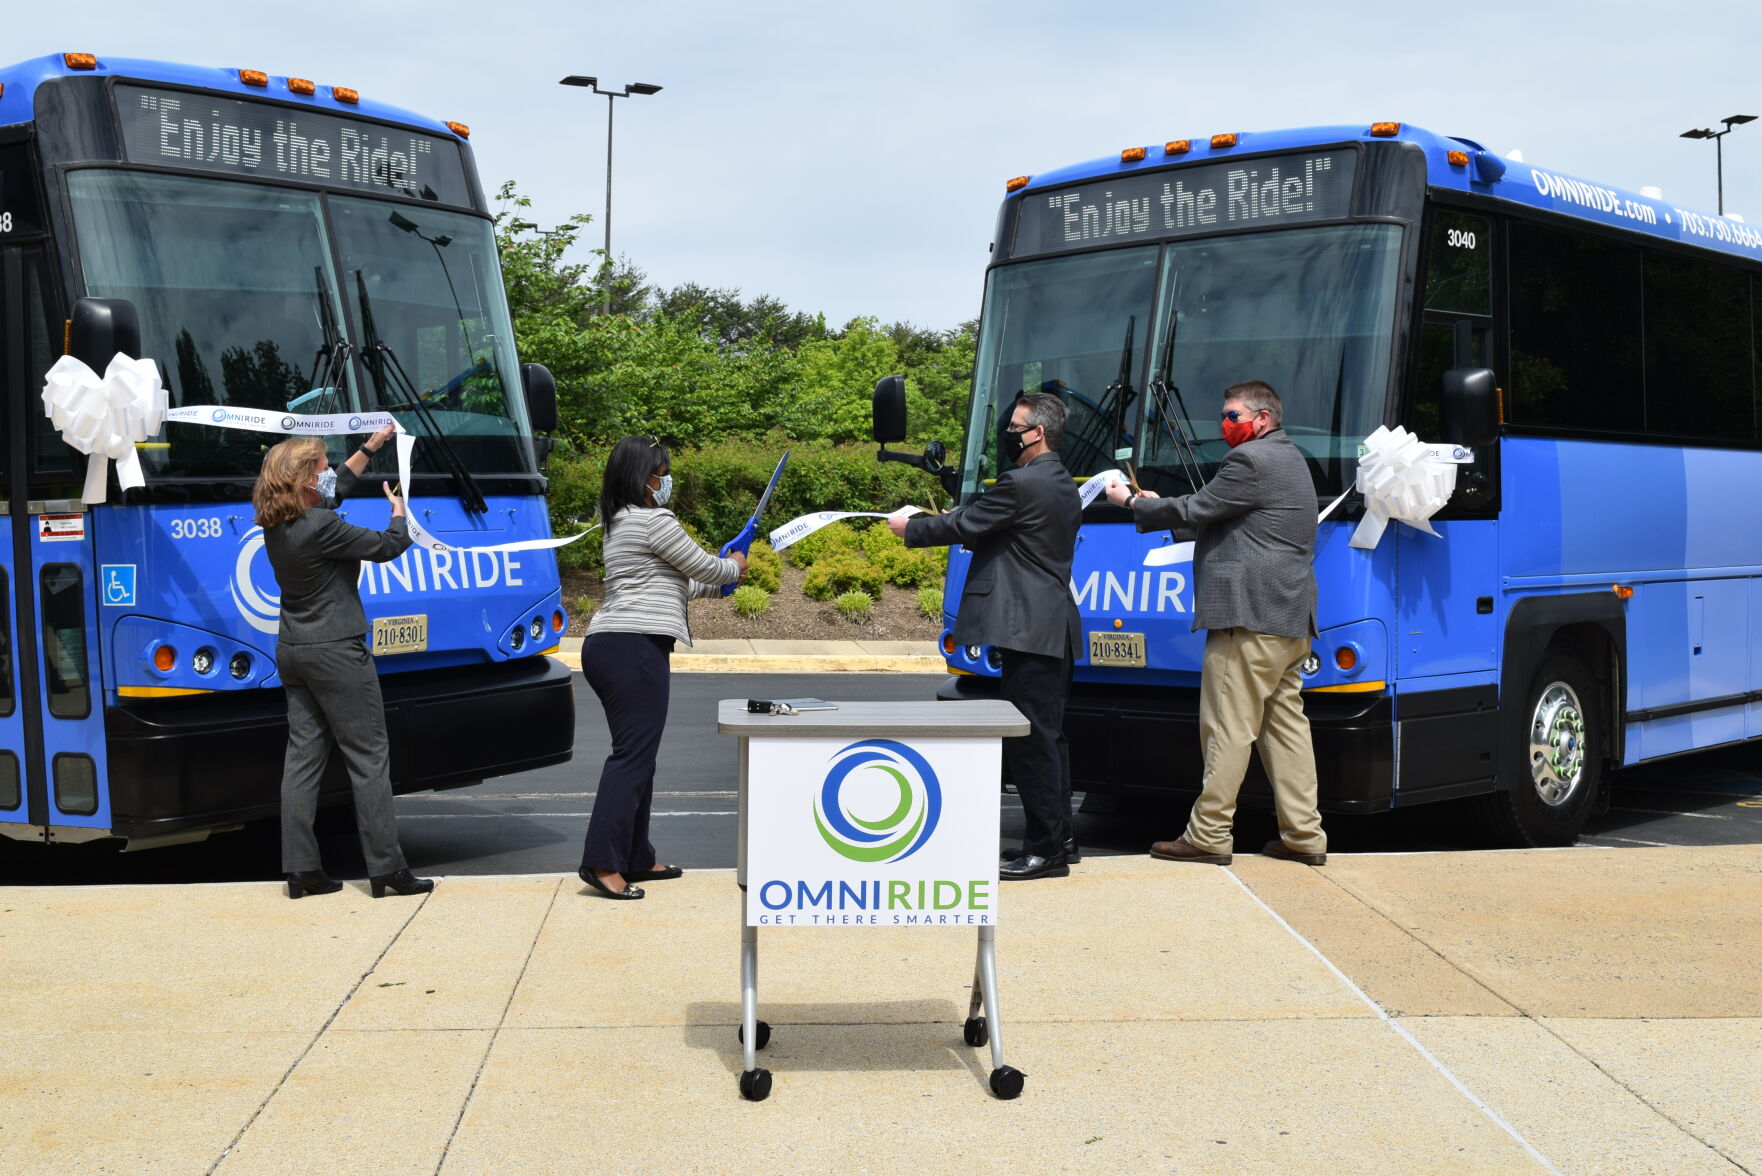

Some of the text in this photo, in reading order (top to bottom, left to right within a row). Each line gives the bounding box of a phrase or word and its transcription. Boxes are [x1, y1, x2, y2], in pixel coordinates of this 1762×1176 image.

[141, 95, 431, 190] "Enjoy the Ride!"
[1048, 157, 1331, 241] "Enjoy the Ride!"
[1531, 168, 1657, 225] OMNIRIDE.com
[1447, 228, 1476, 250] 3040
[170, 517, 222, 539] 3038
[388, 617, 414, 626] VIRGINIA
[759, 880, 989, 910] OMNIRIDE
[760, 914, 988, 924] GET THERE SMARTER
